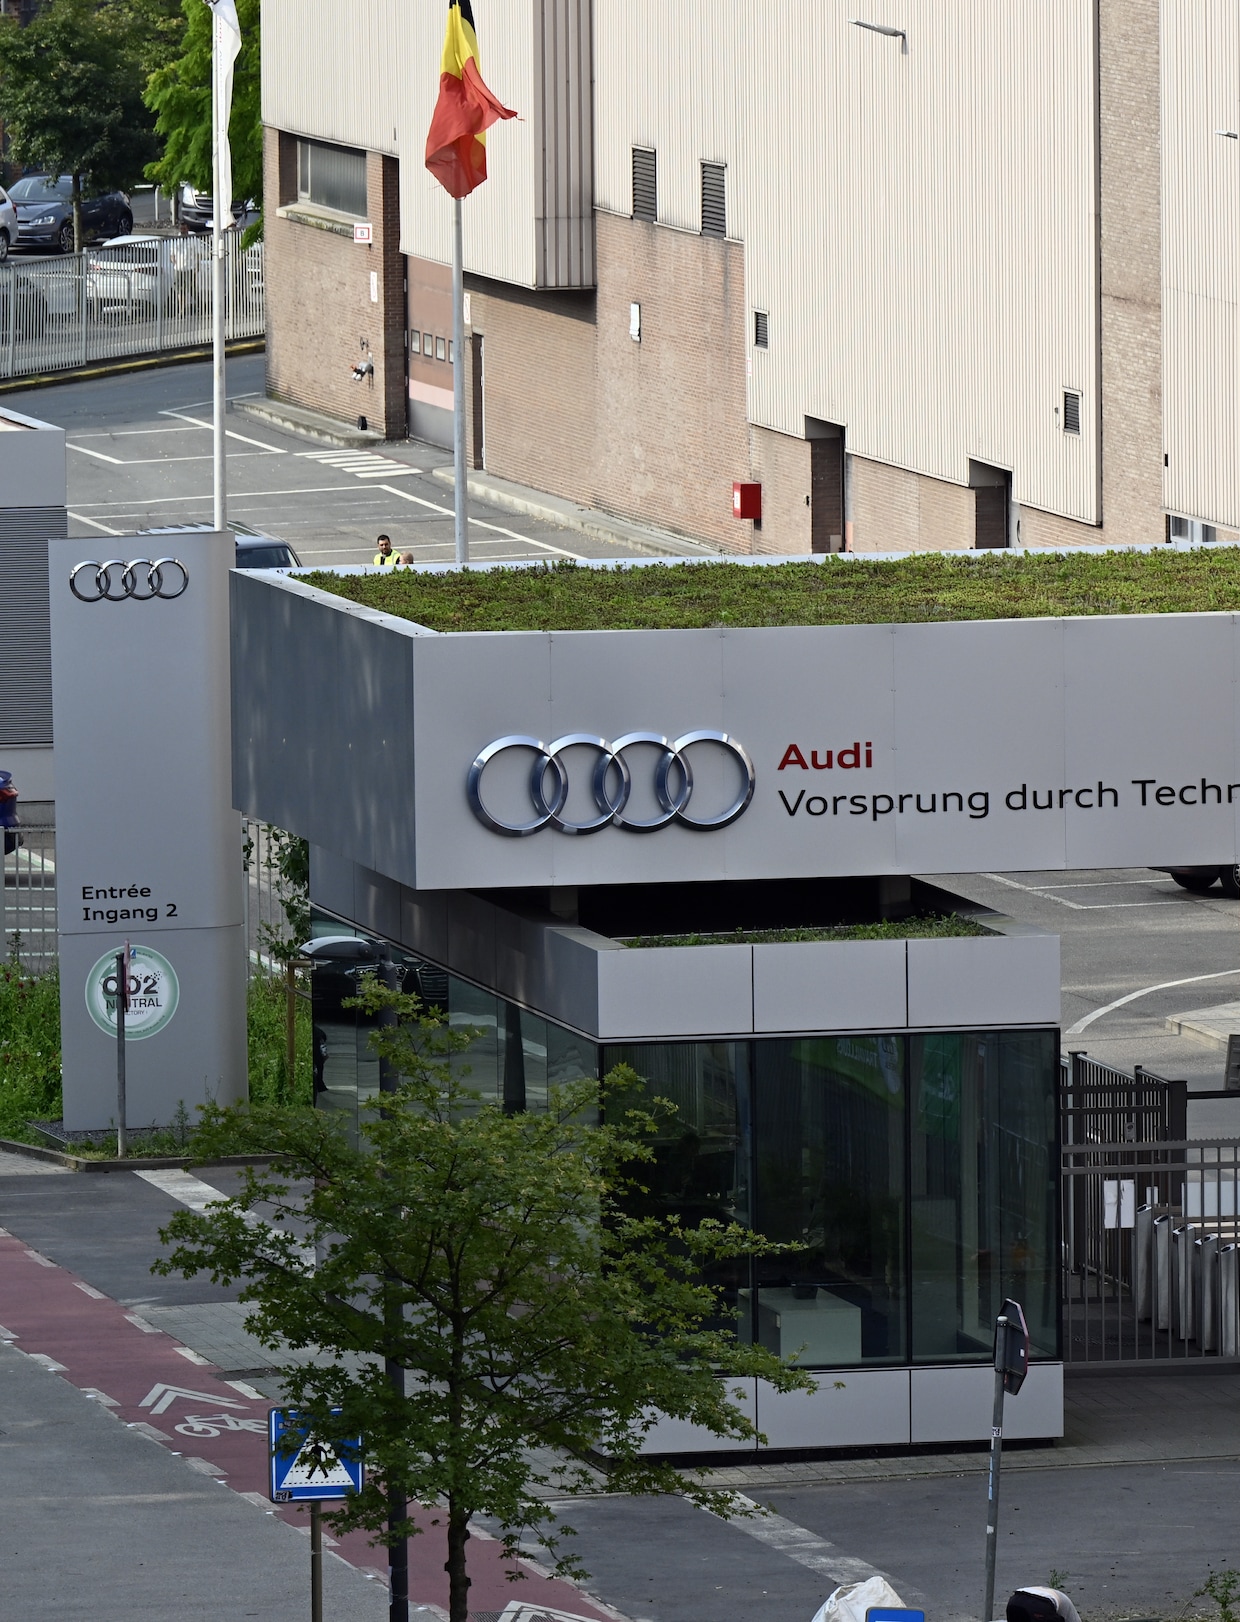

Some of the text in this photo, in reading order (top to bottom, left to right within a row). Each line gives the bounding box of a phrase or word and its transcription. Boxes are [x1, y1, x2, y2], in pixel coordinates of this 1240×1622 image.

[777, 741, 874, 770] Audi
[778, 788, 990, 821] Vorsprung
[1004, 780, 1119, 811] durch
[82, 884, 152, 900] Entrée
[83, 903, 178, 924] Ingang 2
[106, 998, 162, 1010] NTRAL
